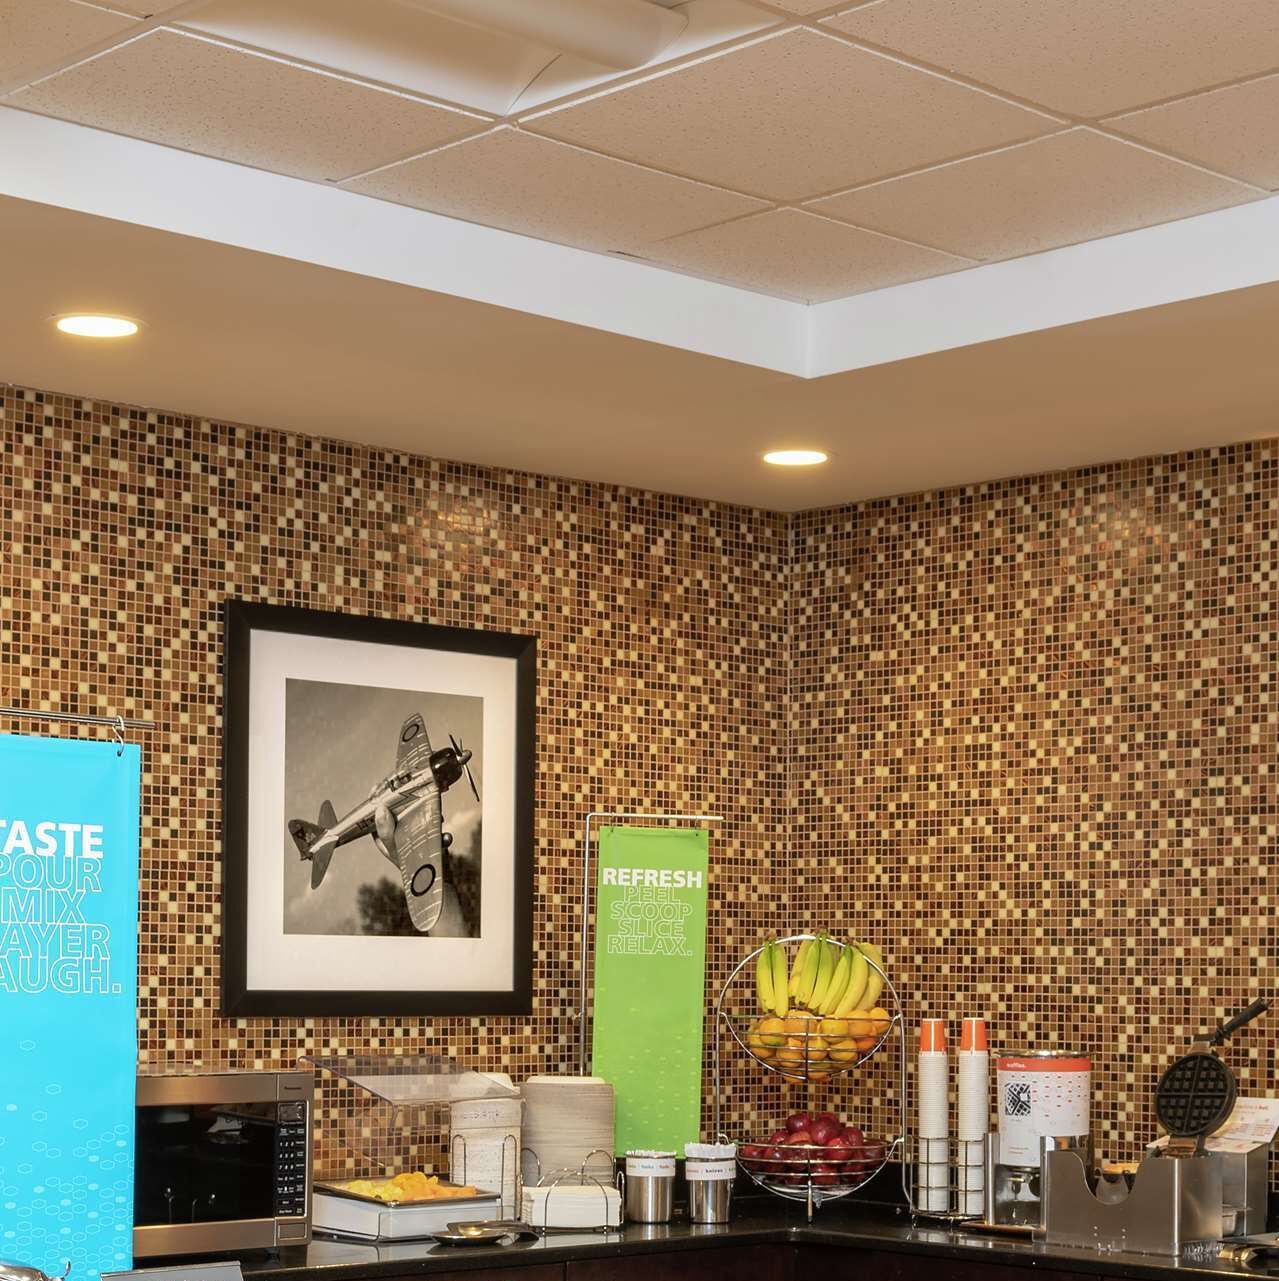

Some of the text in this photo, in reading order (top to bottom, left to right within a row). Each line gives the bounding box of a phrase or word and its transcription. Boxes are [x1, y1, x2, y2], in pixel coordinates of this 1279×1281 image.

[603, 868, 702, 888] REFRESH
[624, 885, 681, 903] PEEL
[0, 887, 86, 924] MIX
[611, 901, 693, 921] SCOOP
[619, 919, 685, 938] SLICE
[608, 936, 693, 956] RELAX.
